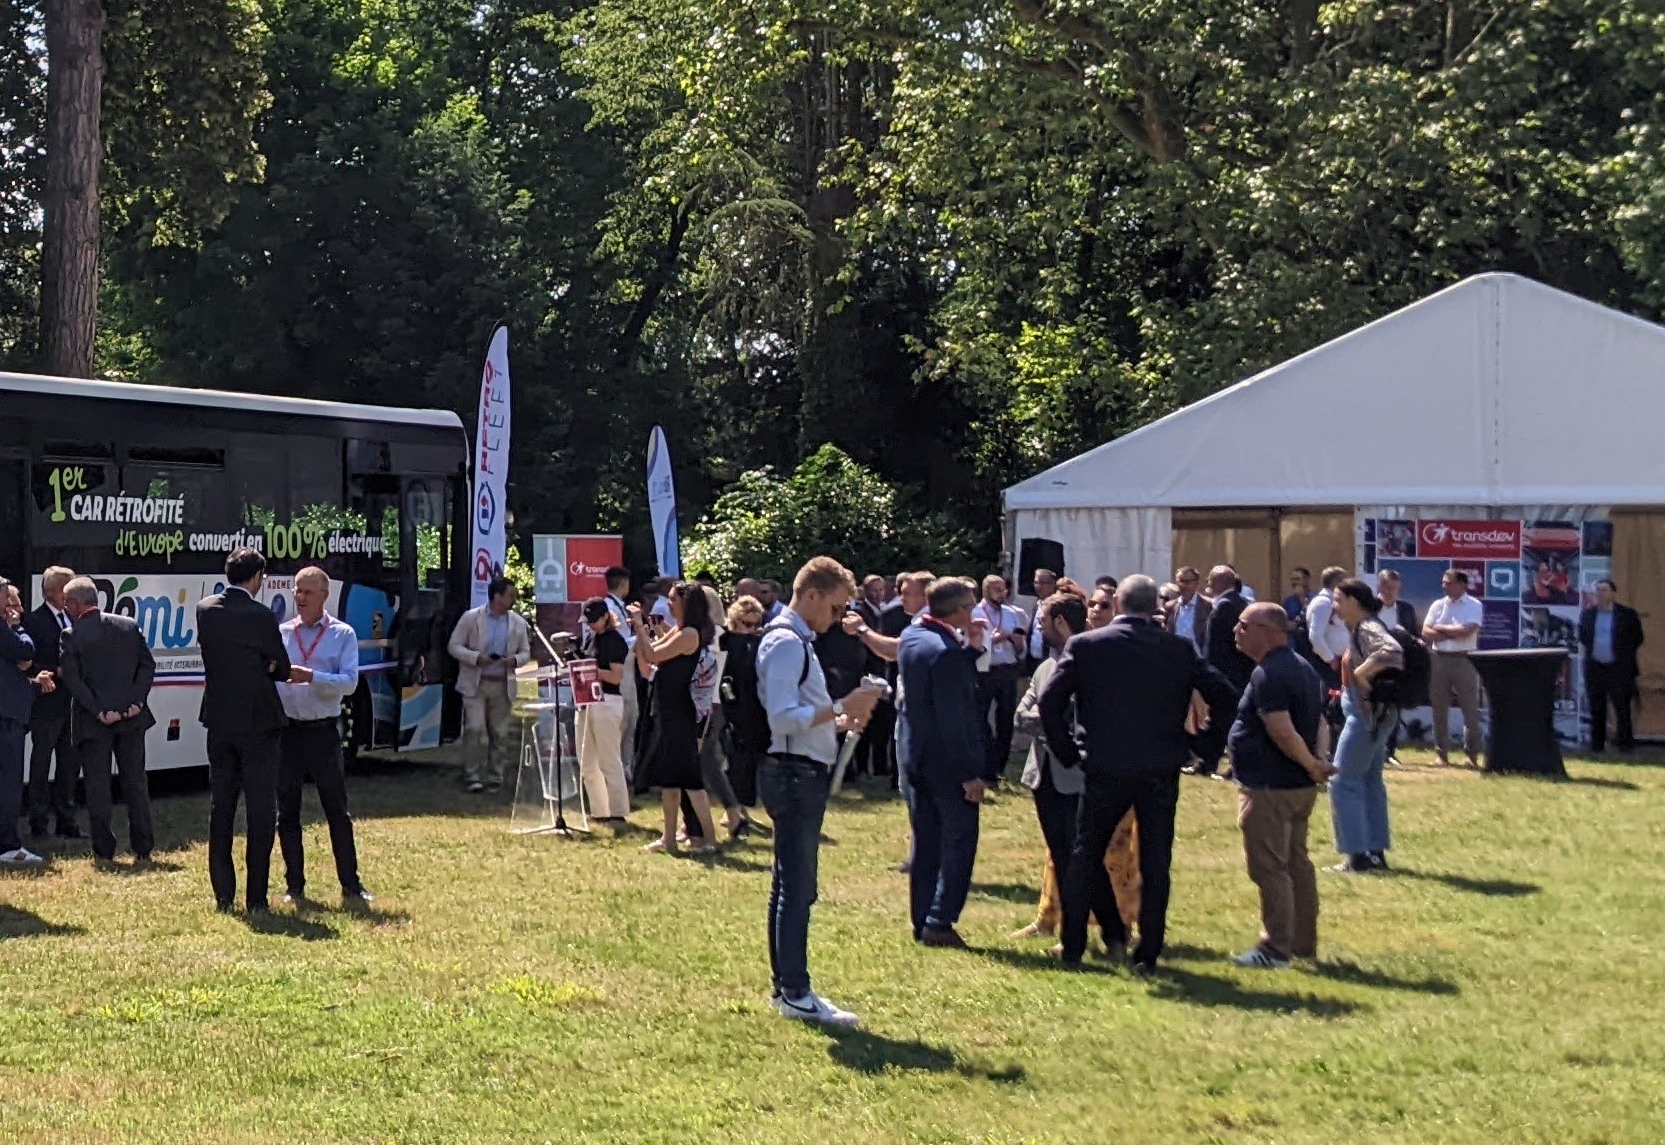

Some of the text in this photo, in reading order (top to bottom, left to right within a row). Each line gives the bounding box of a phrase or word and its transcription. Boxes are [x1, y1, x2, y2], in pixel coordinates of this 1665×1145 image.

[49, 466, 87, 521] 1er
[70, 490, 184, 524] CAR RÉTROFITÉ
[189, 528, 246, 551] converti
[246, 534, 263, 552] en
[1451, 529, 1515, 542] transdev
[267, 579, 291, 589] ADEME
